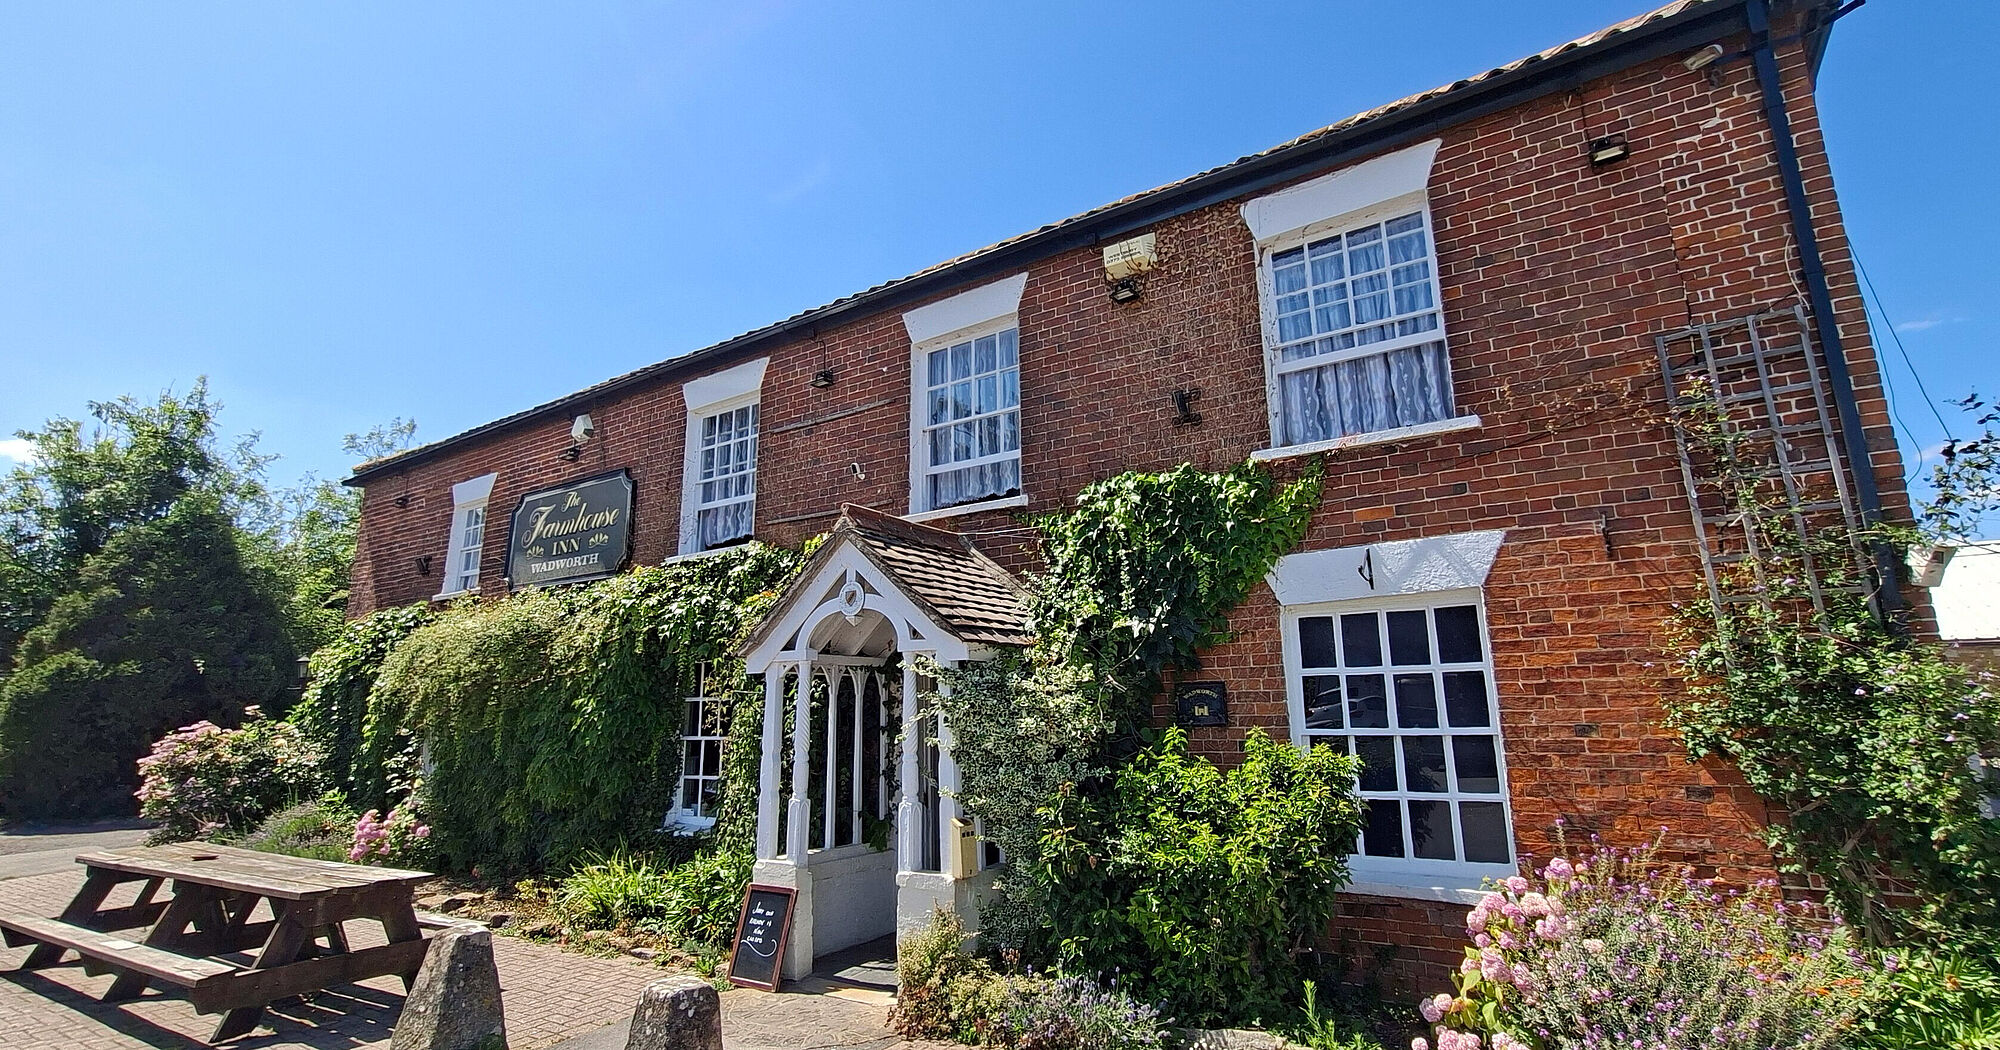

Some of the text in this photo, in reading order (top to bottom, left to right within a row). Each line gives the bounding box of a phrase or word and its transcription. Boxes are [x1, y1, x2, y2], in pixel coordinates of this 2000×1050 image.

[1108, 247, 1138, 259] WESBURY
[561, 491, 581, 512] The
[521, 502, 620, 549] Farmhouse
[552, 537, 580, 556] INN
[531, 552, 600, 574] WADWORTH
[1183, 688, 1218, 699] WADWORTH
